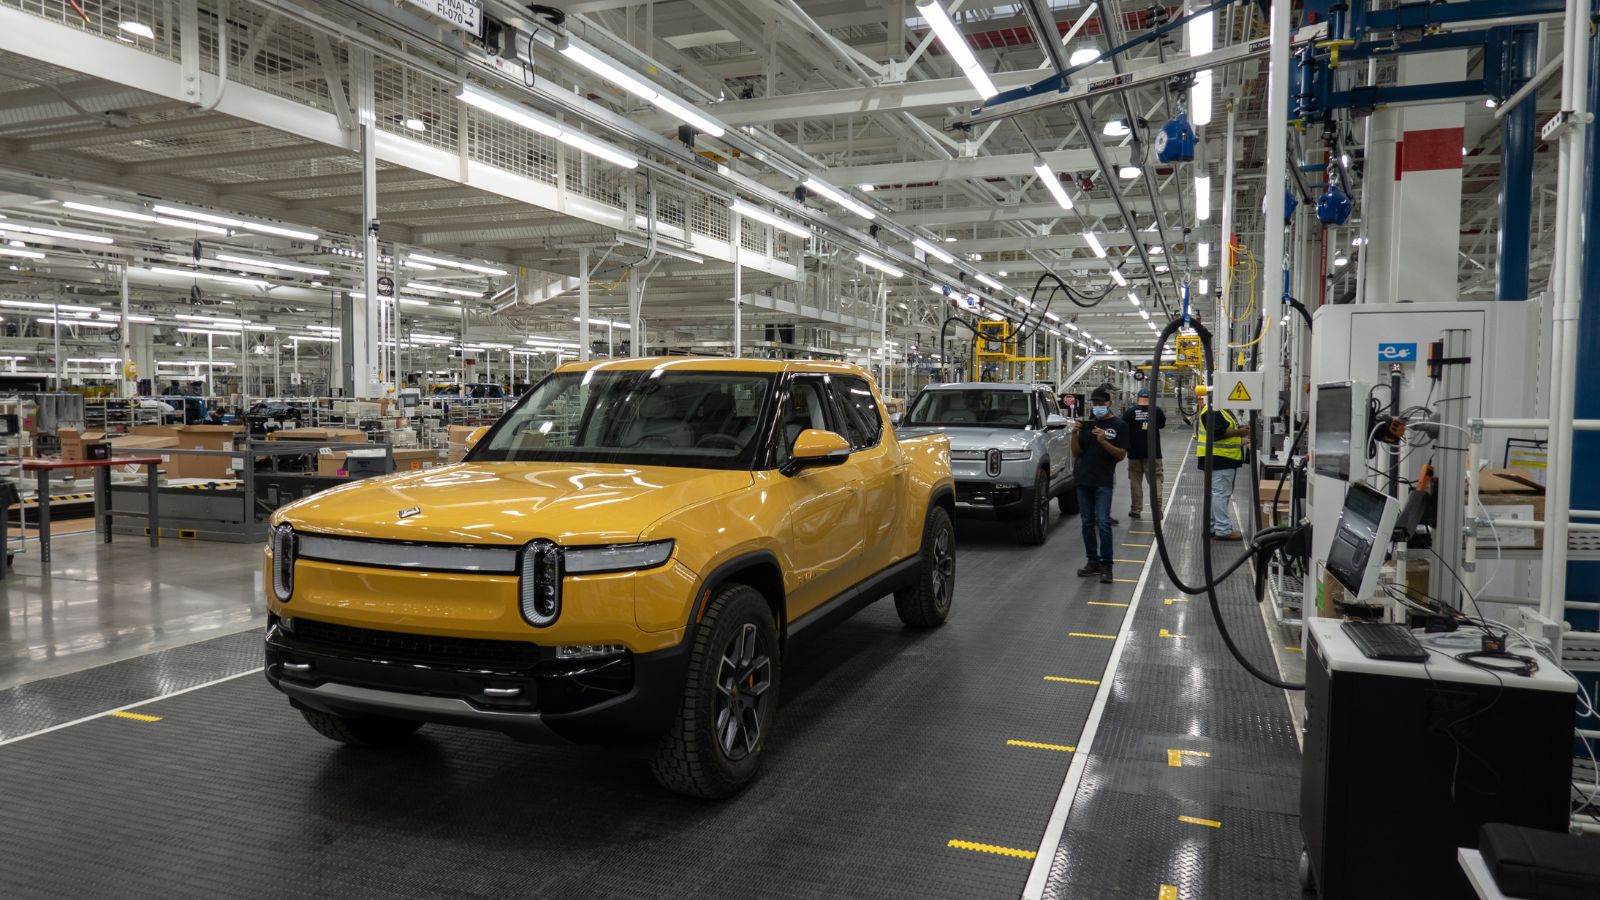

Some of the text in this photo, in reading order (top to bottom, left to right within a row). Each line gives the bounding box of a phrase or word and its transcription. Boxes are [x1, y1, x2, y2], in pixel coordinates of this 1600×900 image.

[437, 2, 463, 24] FI-070
[441, 0, 467, 15] INAL
[469, 7, 474, 18] 2
